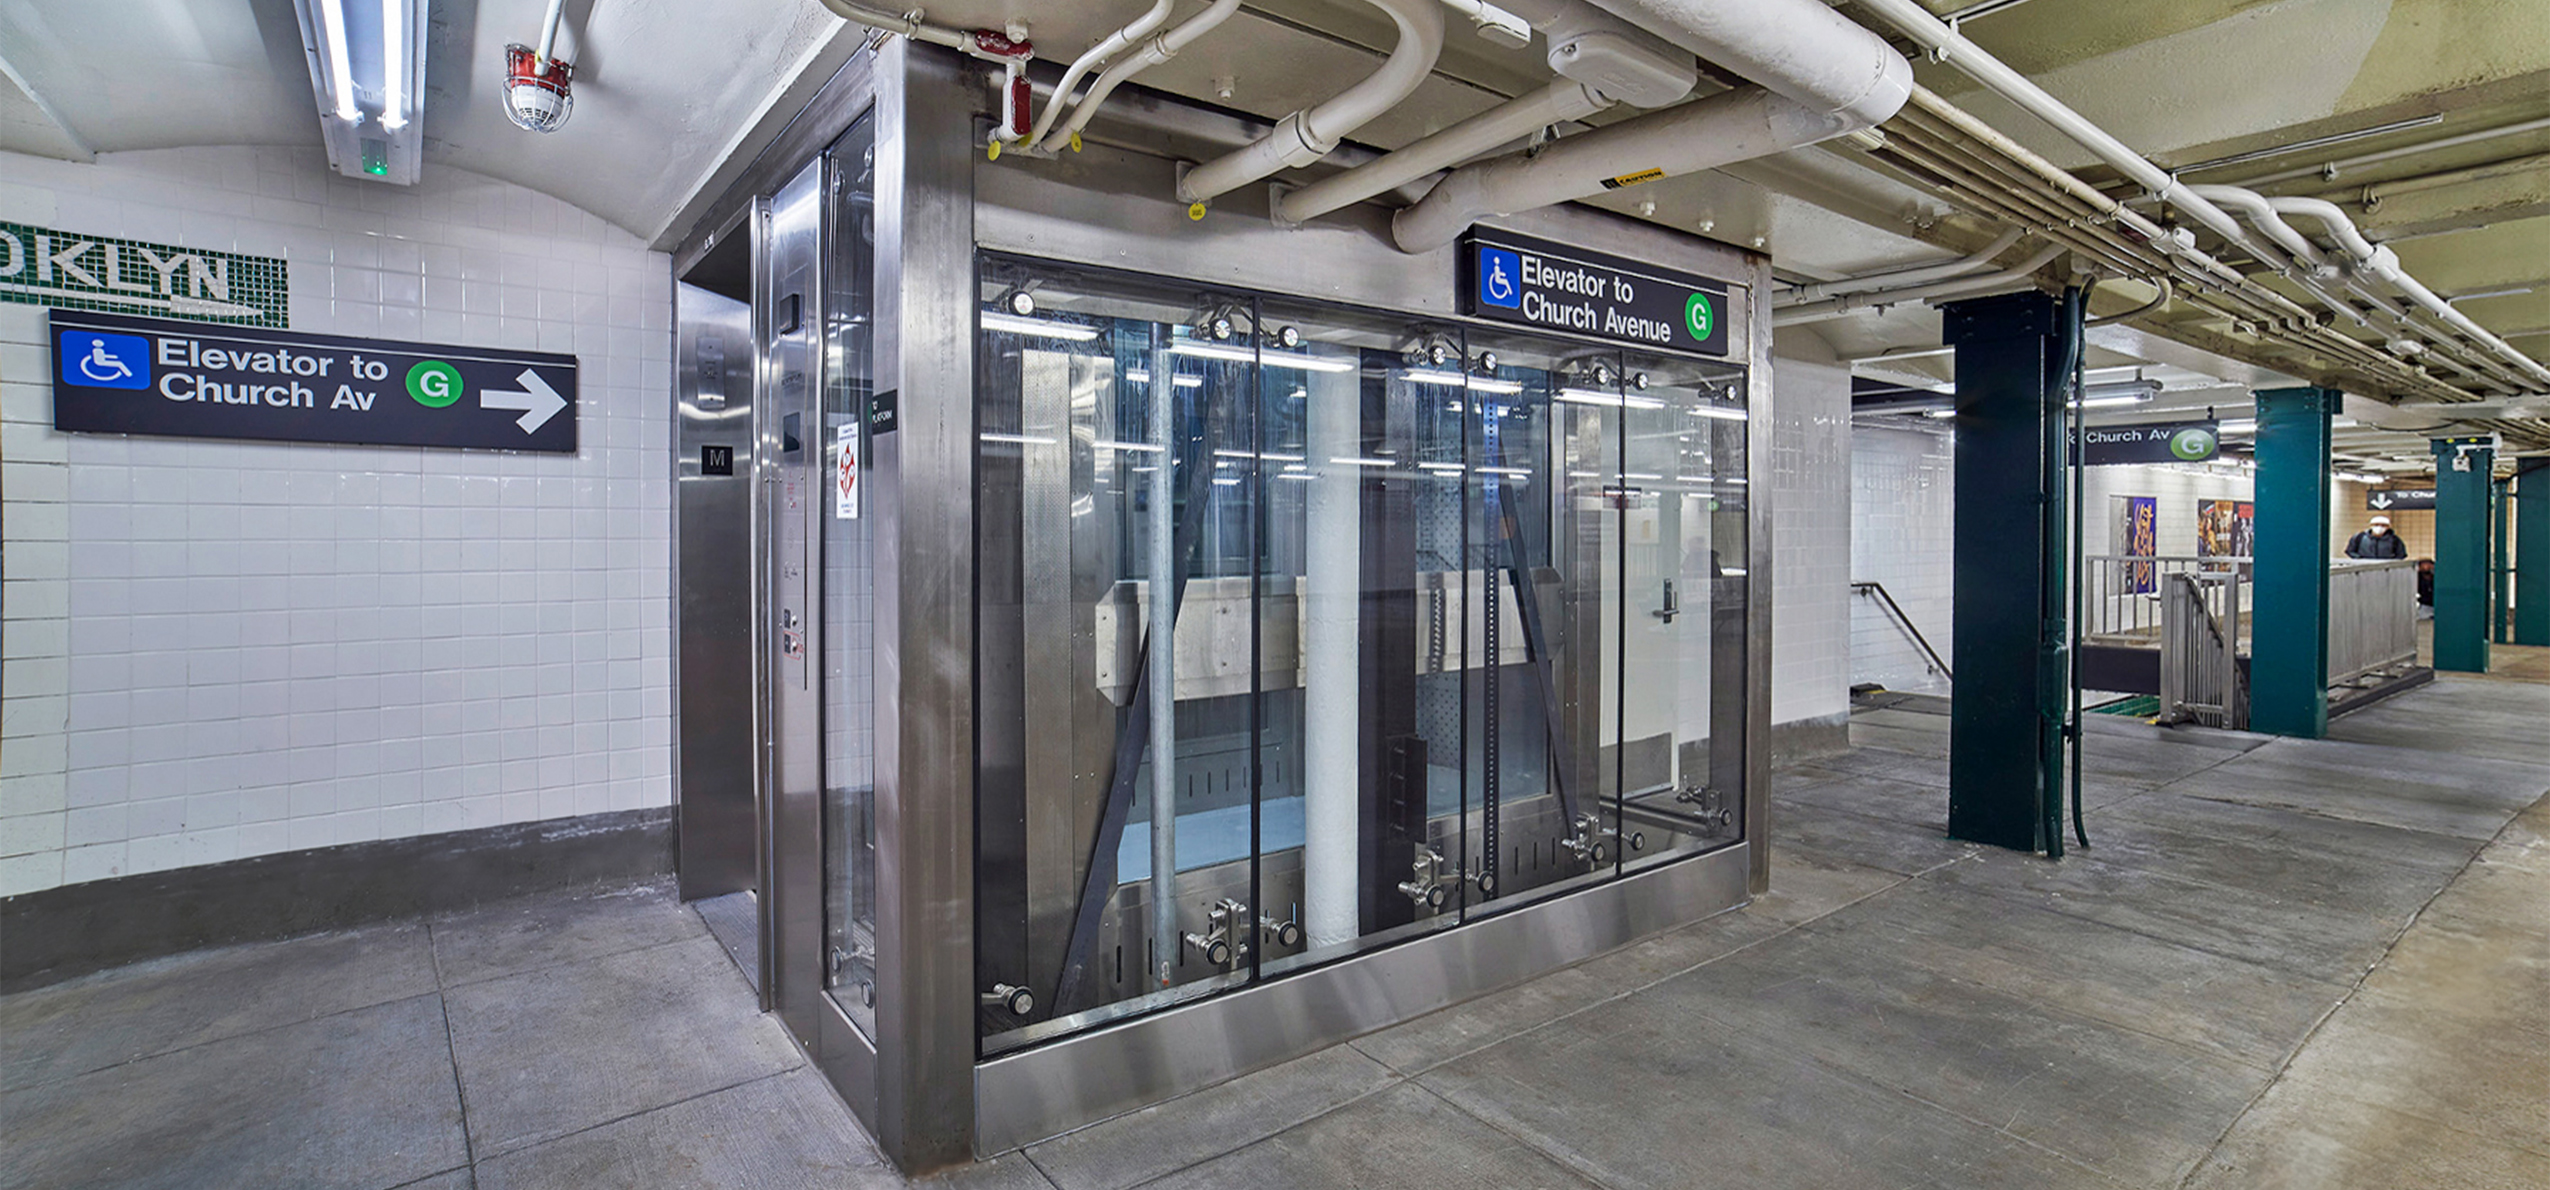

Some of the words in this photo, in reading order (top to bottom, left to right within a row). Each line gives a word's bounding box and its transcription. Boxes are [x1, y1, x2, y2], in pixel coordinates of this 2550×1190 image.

[1521, 255, 1606, 298] Elevator
[1613, 276, 1634, 304] to
[1522, 290, 1597, 330] Church
[1604, 306, 1671, 343] Avenue
[1691, 302, 1707, 331] G
[157, 337, 333, 376] Elevator
[350, 355, 388, 381] to
[158, 372, 314, 408] Church
[330, 384, 376, 411] Av
[419, 370, 449, 397] G
[2086, 430, 2142, 443] Church
[2150, 429, 2170, 440] Av
[2181, 433, 2204, 454] G
[710, 449, 725, 467] M
